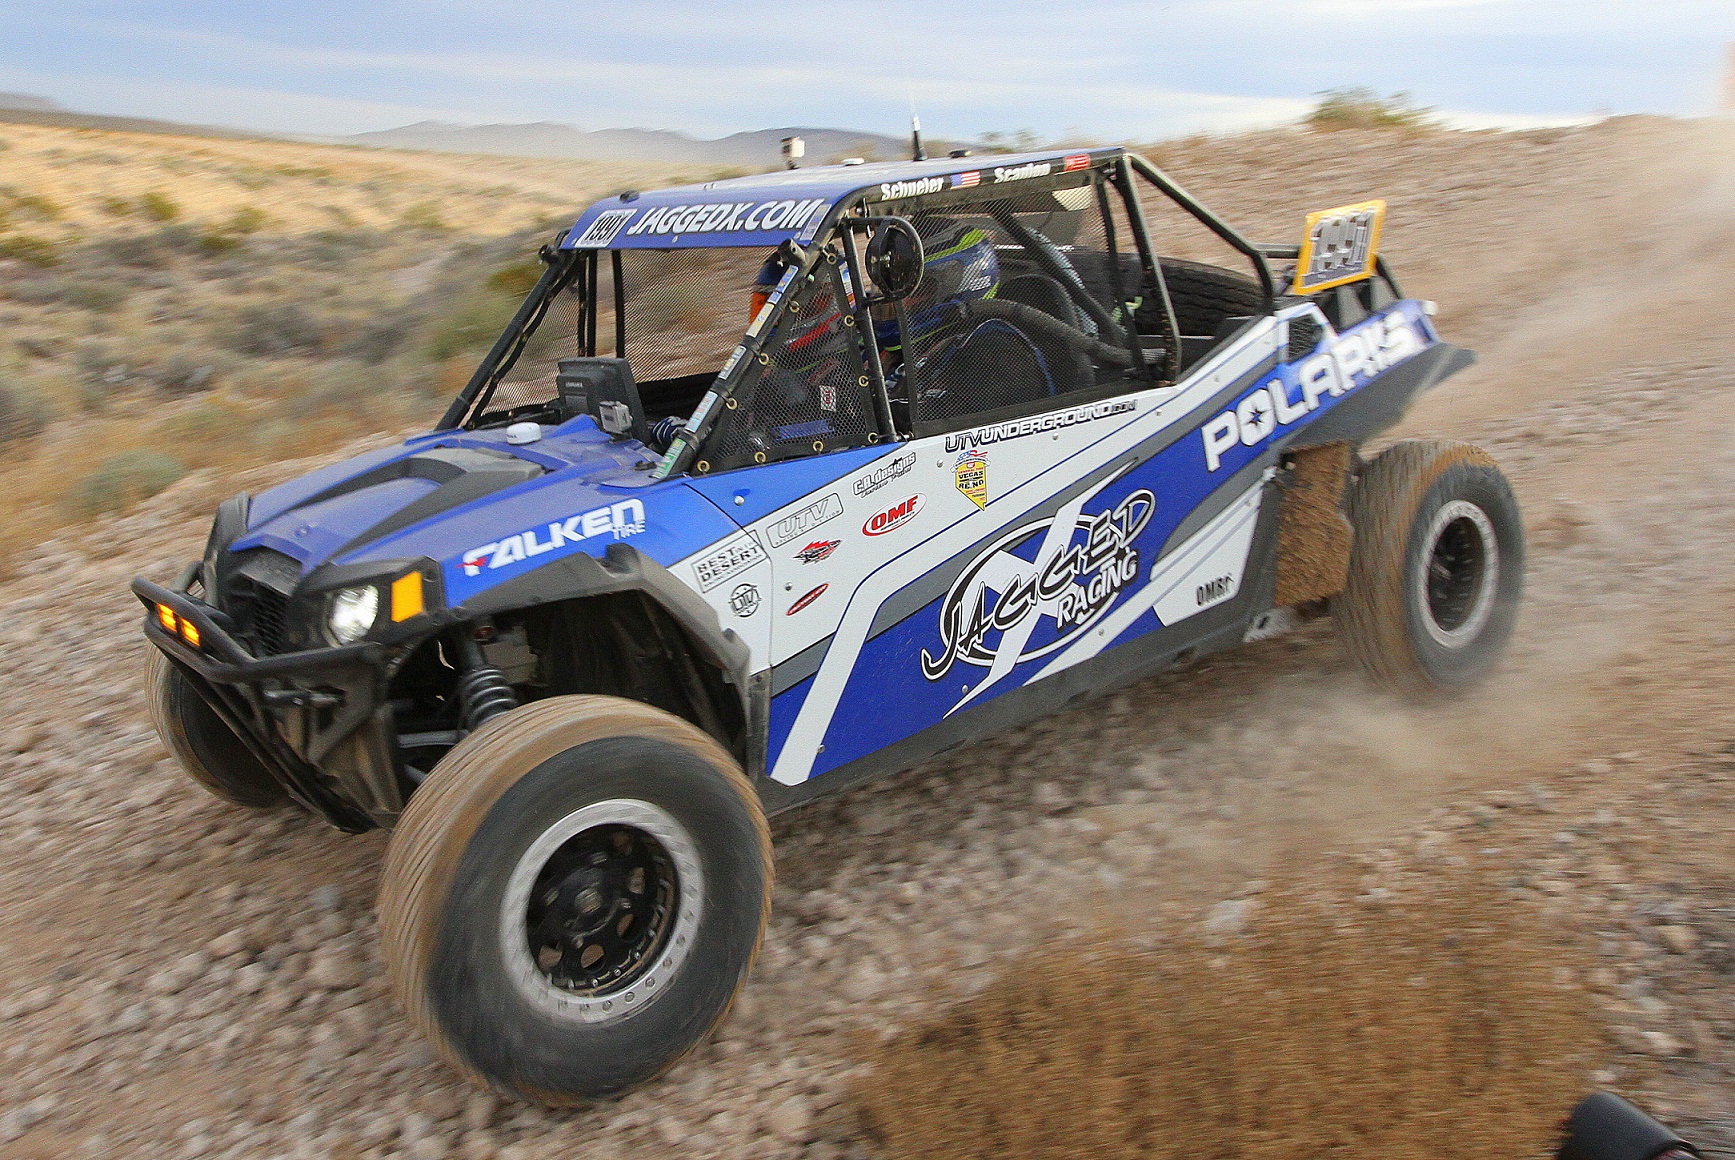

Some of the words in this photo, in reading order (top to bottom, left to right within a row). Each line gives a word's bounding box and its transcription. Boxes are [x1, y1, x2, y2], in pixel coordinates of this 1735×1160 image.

[626, 198, 825, 235] JAGGEDX.COM
[1201, 310, 1419, 473] POLARIS
[958, 470, 984, 480] VEGAS
[611, 519, 646, 540] TIRE
[777, 498, 829, 539] UTV
[871, 494, 919, 531] OMF
[460, 498, 646, 577] FALKEN
[698, 546, 735, 574] BEST
[701, 544, 760, 582] DESERT
[921, 489, 1156, 682] JAGGED
[1056, 548, 1139, 633] RACING
